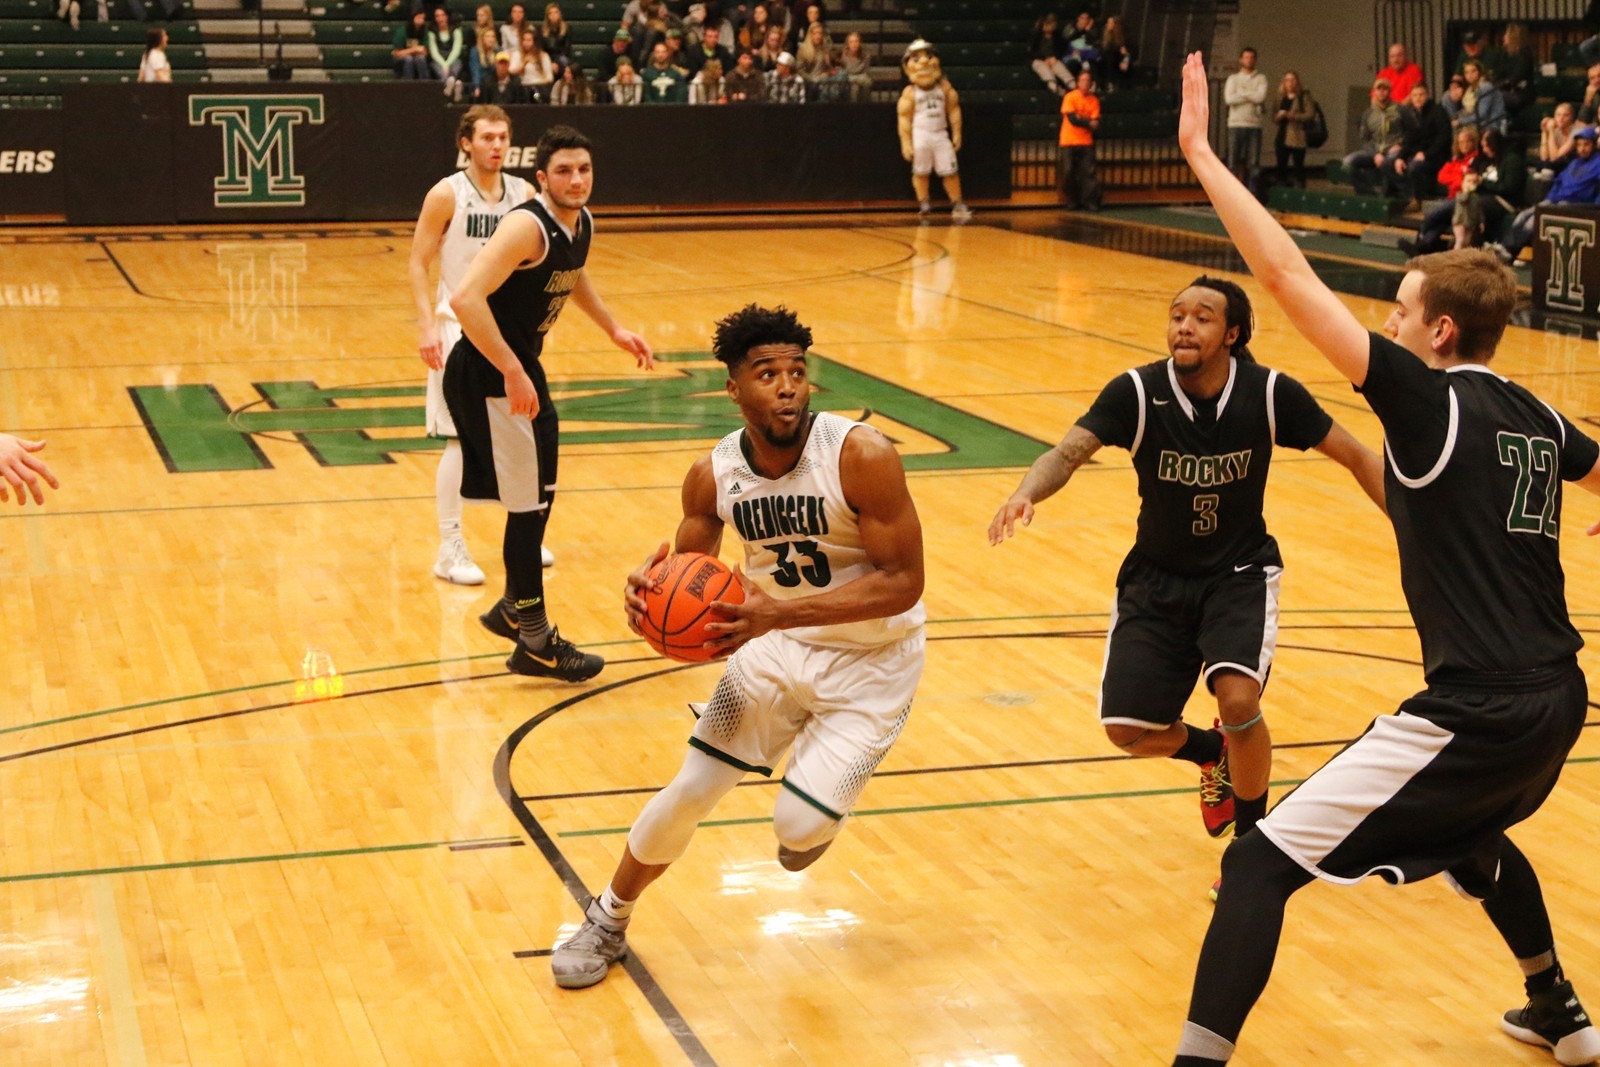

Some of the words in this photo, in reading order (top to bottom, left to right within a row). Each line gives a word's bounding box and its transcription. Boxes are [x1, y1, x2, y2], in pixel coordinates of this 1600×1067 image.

[0, 150, 55, 173] ERS
[1158, 449, 1252, 488] ROCKY
[1496, 430, 1559, 540] 22
[732, 494, 829, 541] OREDIGGERS
[1192, 494, 1219, 536] 3
[762, 540, 832, 588] 33
